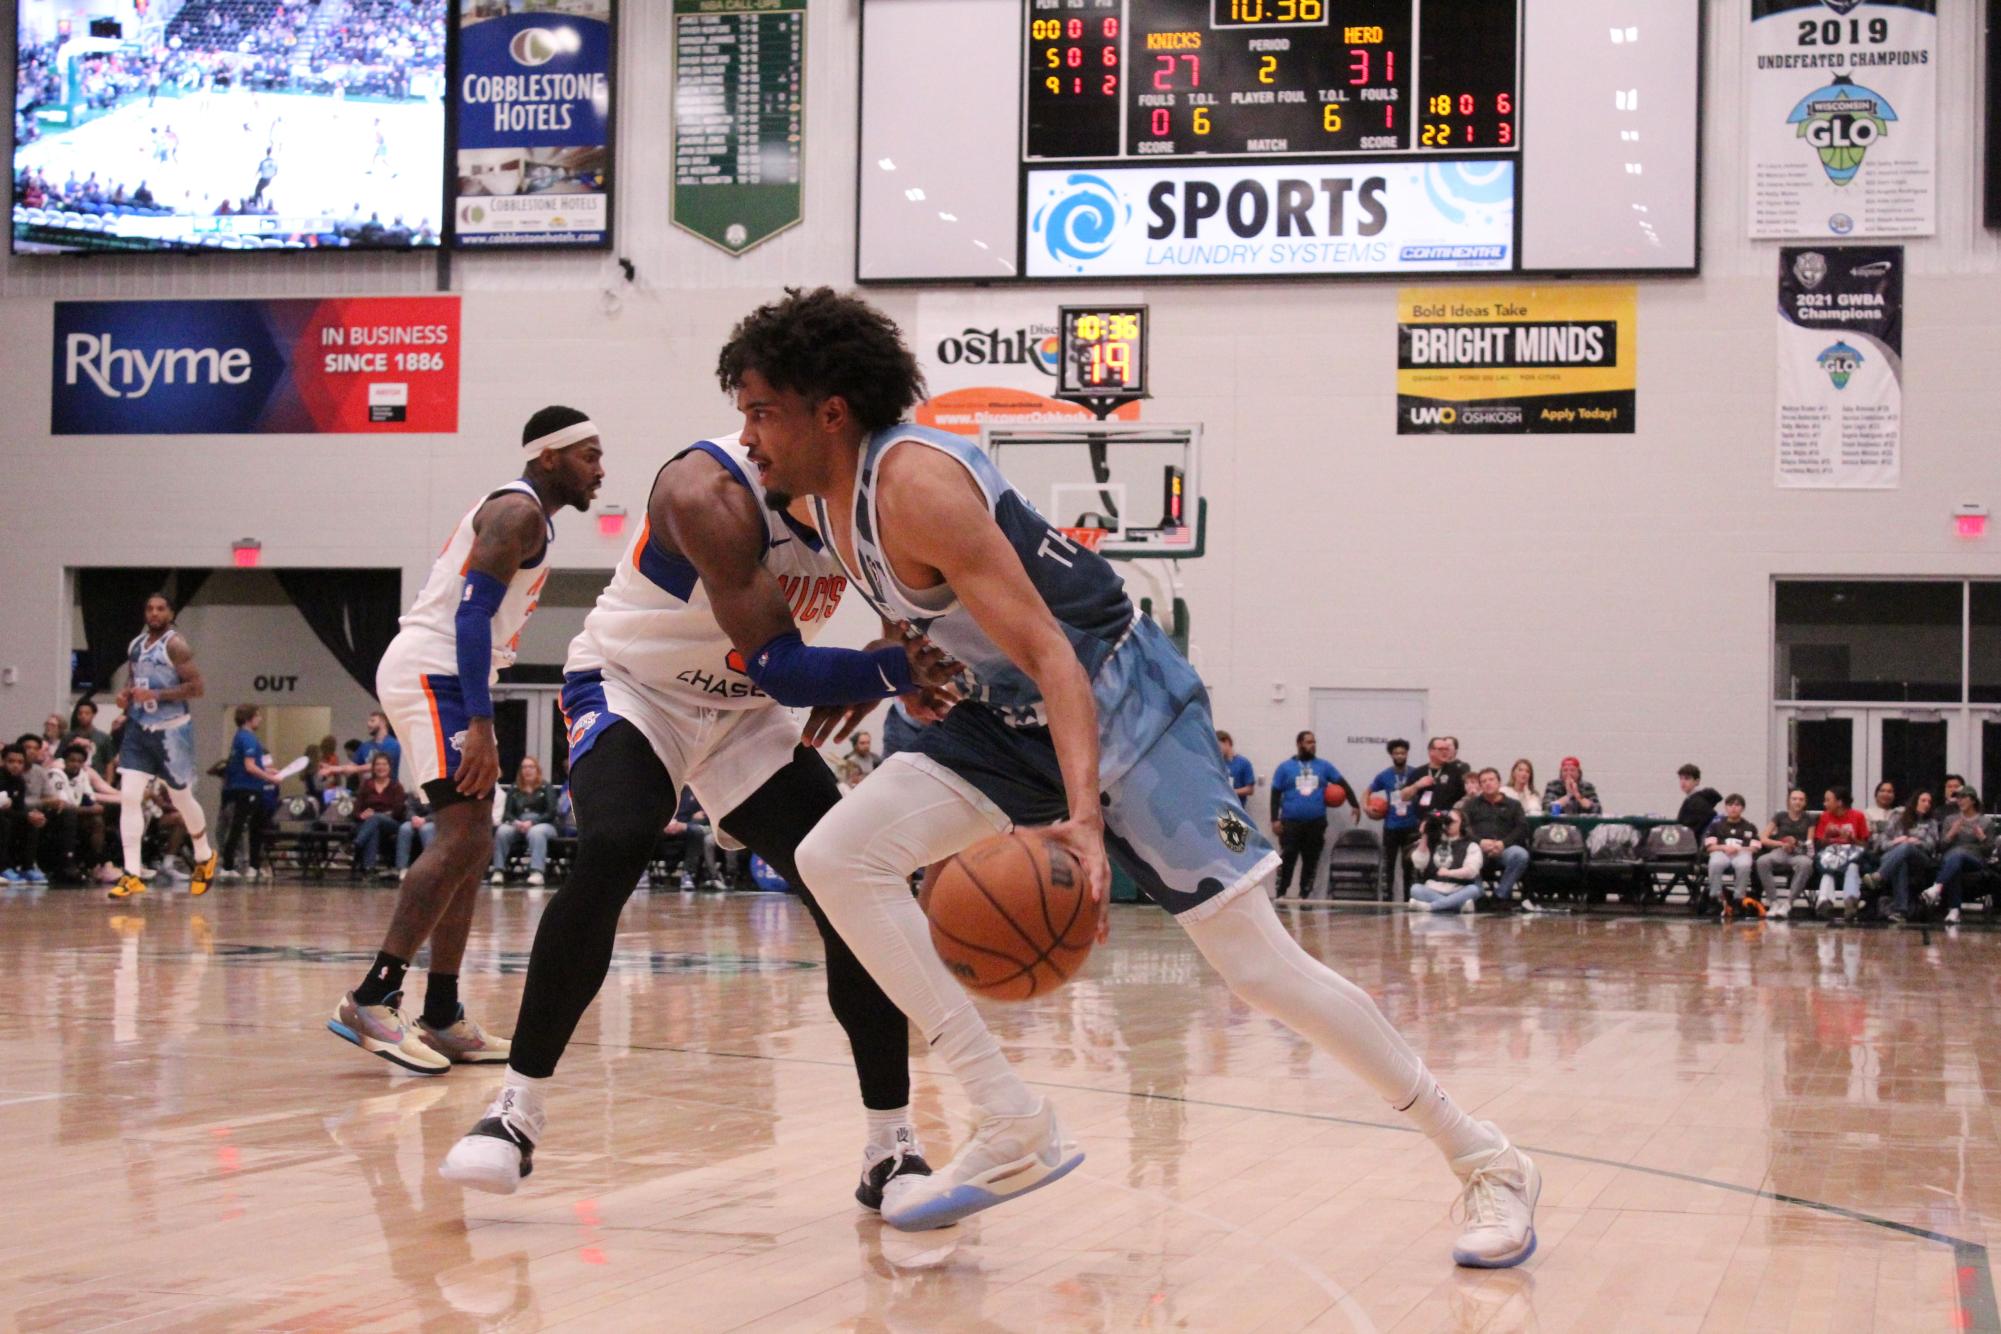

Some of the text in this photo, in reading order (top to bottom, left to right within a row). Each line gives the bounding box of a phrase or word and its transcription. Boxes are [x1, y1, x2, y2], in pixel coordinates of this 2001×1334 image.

[1032, 17, 1118, 40] 00 0 0
[1344, 26, 1384, 44] HERD
[1798, 18, 1888, 46] 2019
[1147, 32, 1201, 50] KNICKS
[1249, 38, 1290, 50] PERIOD
[1046, 45, 1118, 68] 5 0 6
[1350, 50, 1394, 85] 31
[1757, 50, 1928, 69] UNDEFEATED CHAMPIONS
[1153, 54, 1200, 90] 27
[1259, 55, 1277, 84] 2
[463, 73, 606, 103] COBBLESTONE
[1045, 74, 1117, 96] 9 1 2
[1360, 88, 1399, 101] FOULS
[1138, 94, 1175, 107] FOULS
[1231, 91, 1307, 104] PLAYER FOUL
[1430, 93, 1511, 116] 18 0 6
[1814, 101, 1870, 112] WISCONSIN
[494, 102, 573, 131] HOTELS
[1152, 108, 1170, 136] 0
[1193, 107, 1211, 135] 6
[1323, 103, 1342, 132] 6
[1386, 104, 1392, 128] 1
[1360, 136, 1398, 149] SCORE
[1422, 122, 1511, 145] 22 1 3
[1805, 117, 1879, 149] GLO
[1138, 141, 1175, 154] SCORE
[1247, 138, 1288, 151] MATCH
[1147, 176, 1388, 240] SPORTS
[1145, 242, 1388, 266] LAUNDRY SYSTEMS
[1412, 303, 1527, 318] Bold Ideas Take
[1796, 293, 1885, 306] 2021 GWBA
[1798, 307, 1882, 321] Champions
[322, 325, 448, 346] IN BUSINESS
[1077, 315, 1138, 340] 10:36
[1411, 325, 1604, 364] BRIGHT MINDS
[66, 333, 251, 399] Rhyme
[324, 352, 444, 373] SINCE 1886
[1092, 342, 1130, 384] 19
[1824, 359, 1857, 373] GLO
[1411, 406, 1456, 424] UWO
[1462, 412, 1522, 424] OSHKOSH
[1540, 407, 1617, 422] Apply Today!
[254, 675, 298, 691] OUT
[676, 669, 767, 698] CHASE
